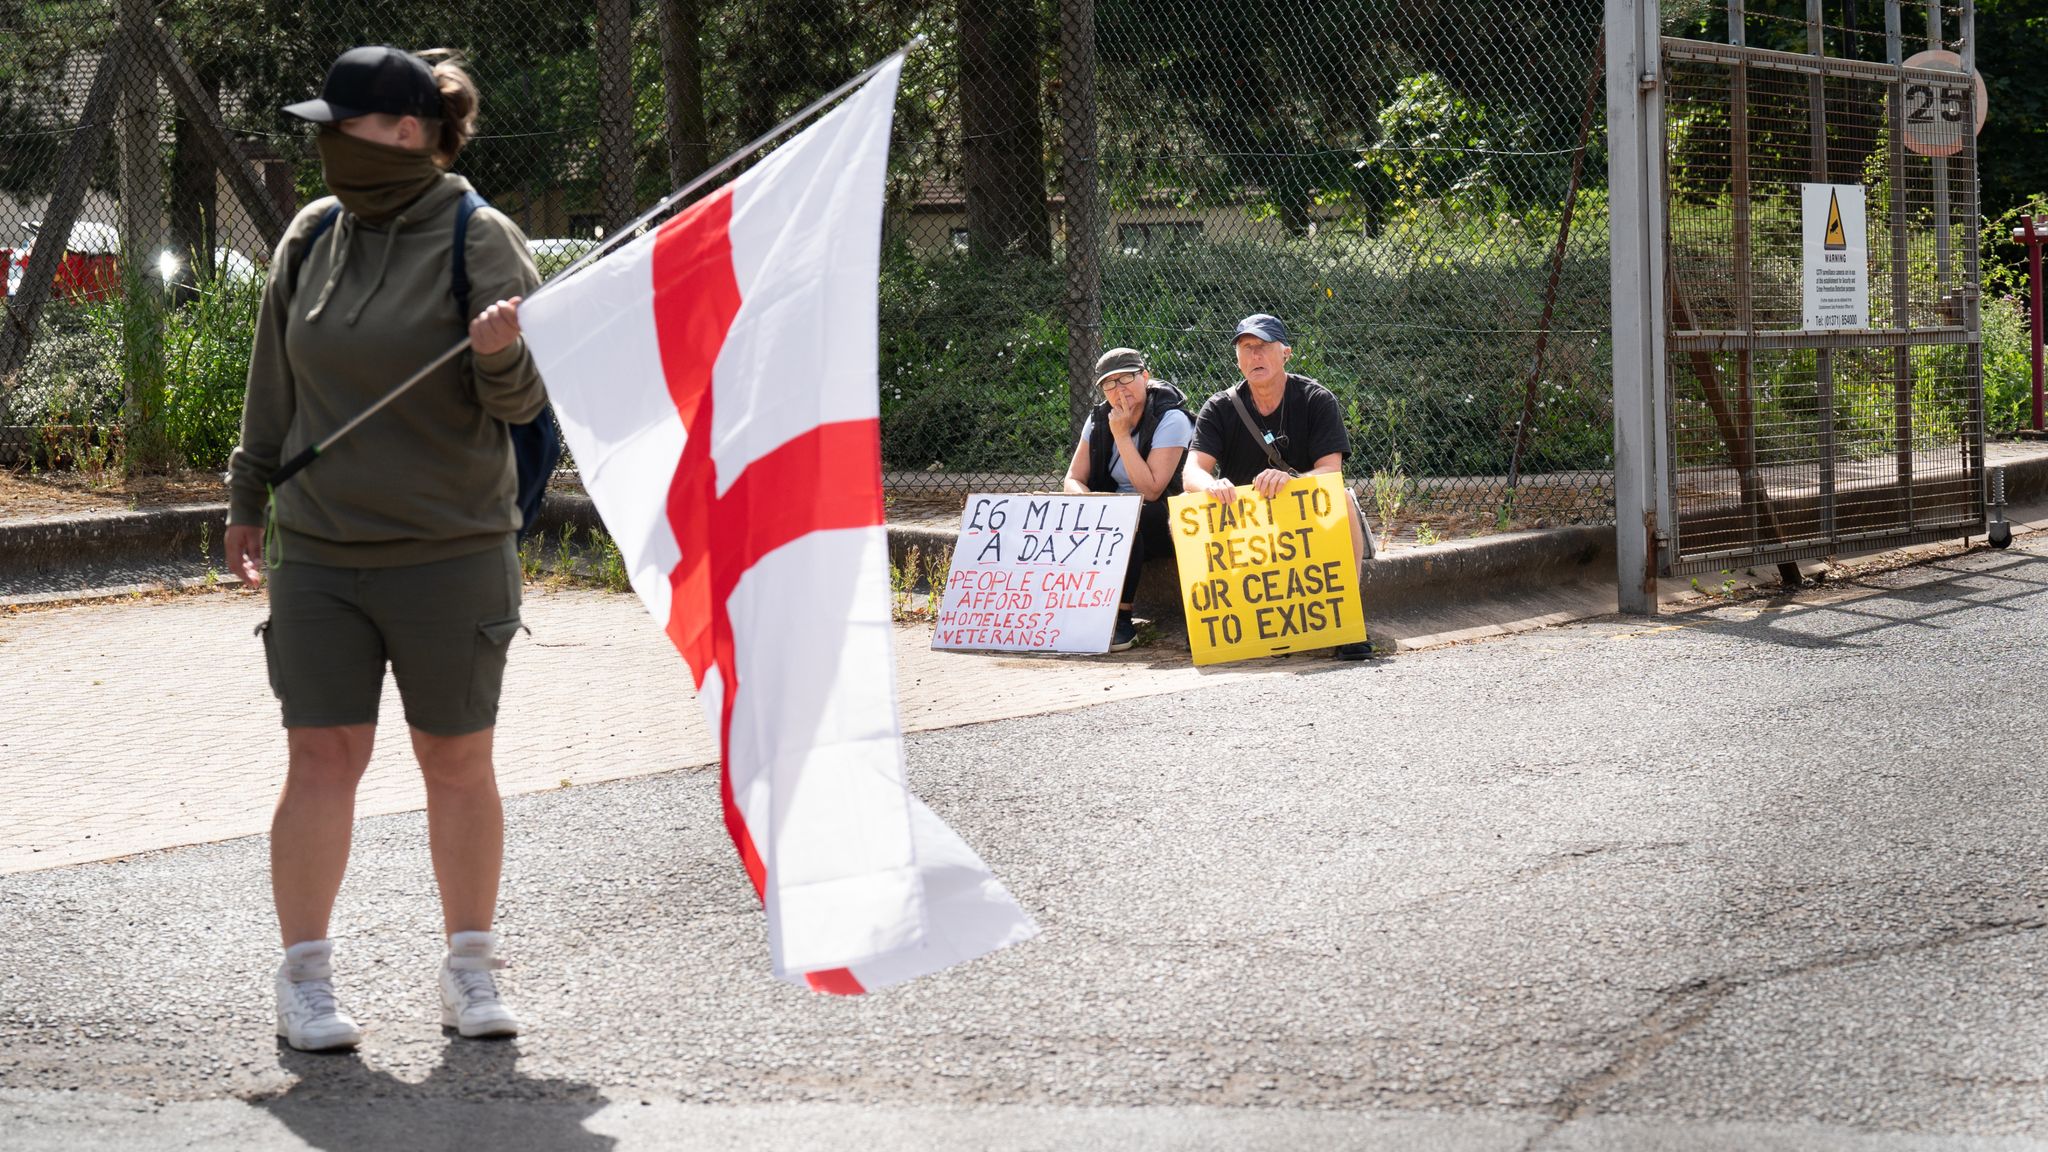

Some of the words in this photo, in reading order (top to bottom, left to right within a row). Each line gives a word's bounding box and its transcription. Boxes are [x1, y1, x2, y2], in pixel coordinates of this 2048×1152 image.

[1906, 85, 1963, 124] 25
[1825, 253, 1846, 263] WARNING
[968, 499, 1009, 531] £6
[1180, 494, 1278, 536] START
[1291, 487, 1331, 520] TO
[977, 532, 1001, 562] A
[1204, 528, 1313, 572] RESIST
[951, 570, 1034, 591] PEOPLE
[1191, 579, 1232, 612] OR
[1242, 561, 1344, 604] CEASE
[957, 591, 1032, 610] AFFORD
[1045, 588, 1115, 609] BILLS!!
[944, 611, 1055, 630] HOMELESS?
[1201, 613, 1242, 647] TO
[1255, 597, 1344, 640] EXIST
[943, 629, 1060, 647] VETERANS?
